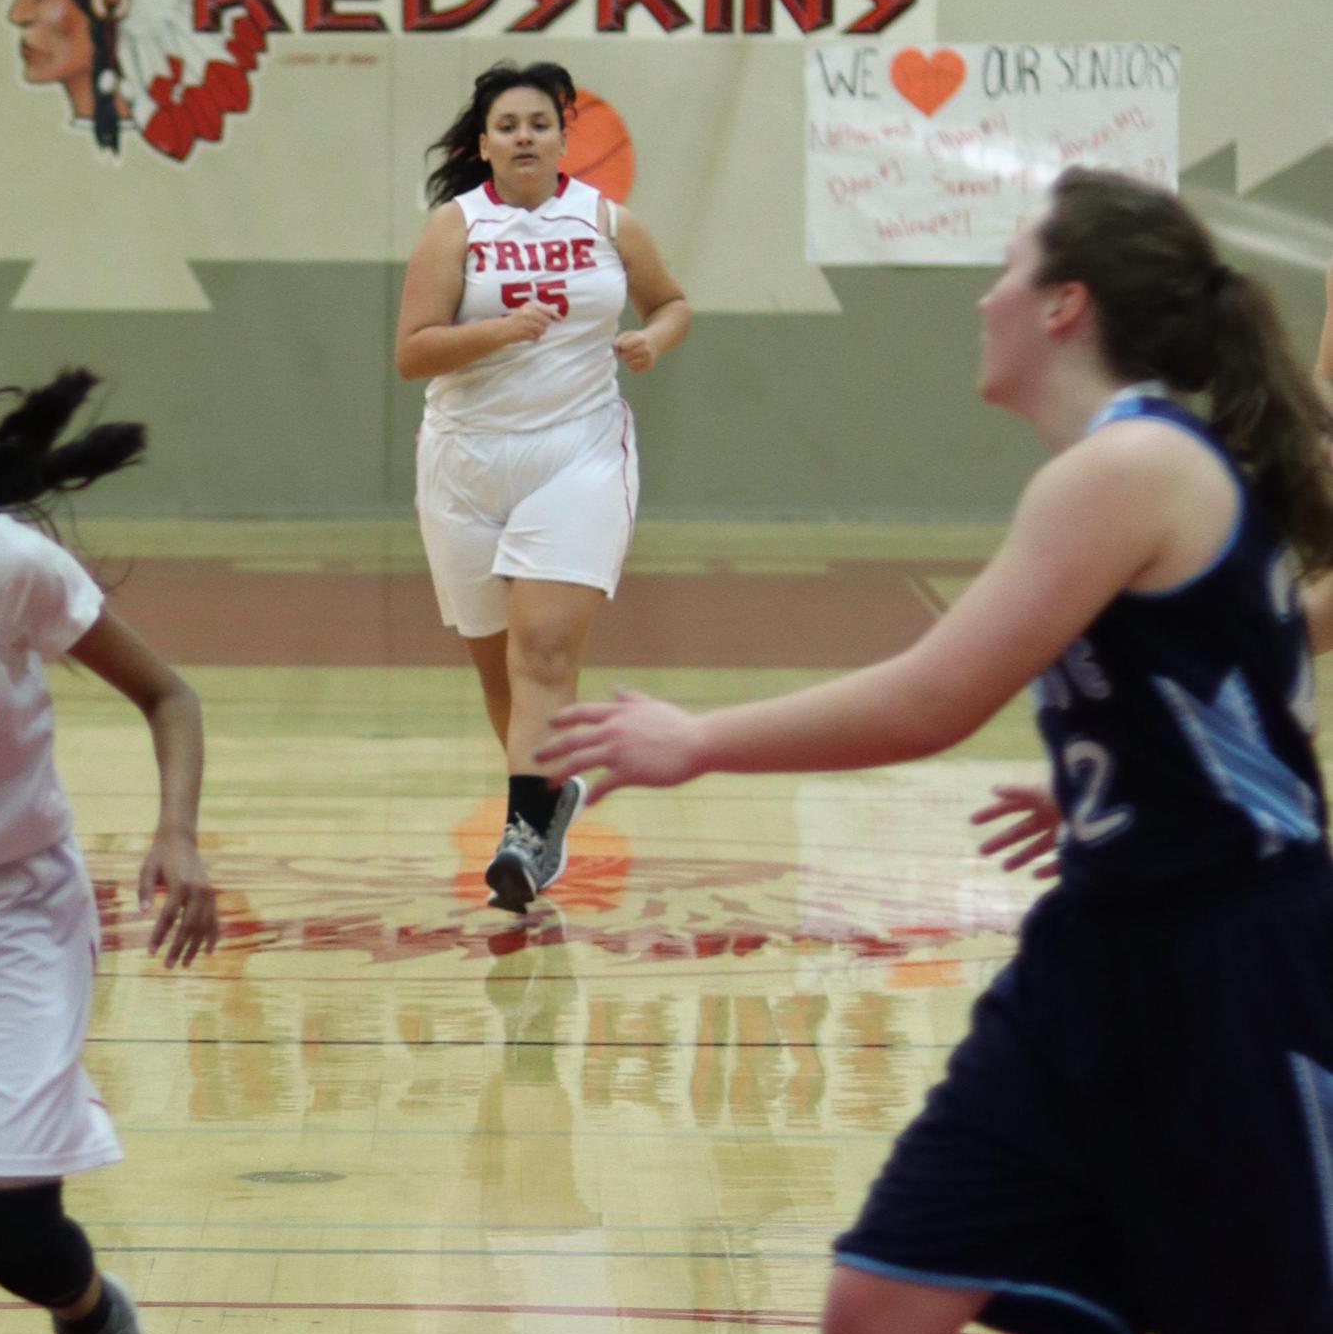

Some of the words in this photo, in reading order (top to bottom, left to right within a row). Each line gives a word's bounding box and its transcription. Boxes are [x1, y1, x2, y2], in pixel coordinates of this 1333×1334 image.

[816, 46, 879, 100] WE
[982, 45, 1042, 100] OUR
[1053, 44, 1180, 94] SENIORS
[468, 238, 597, 272] TRIBE
[1062, 737, 1132, 845] 2
